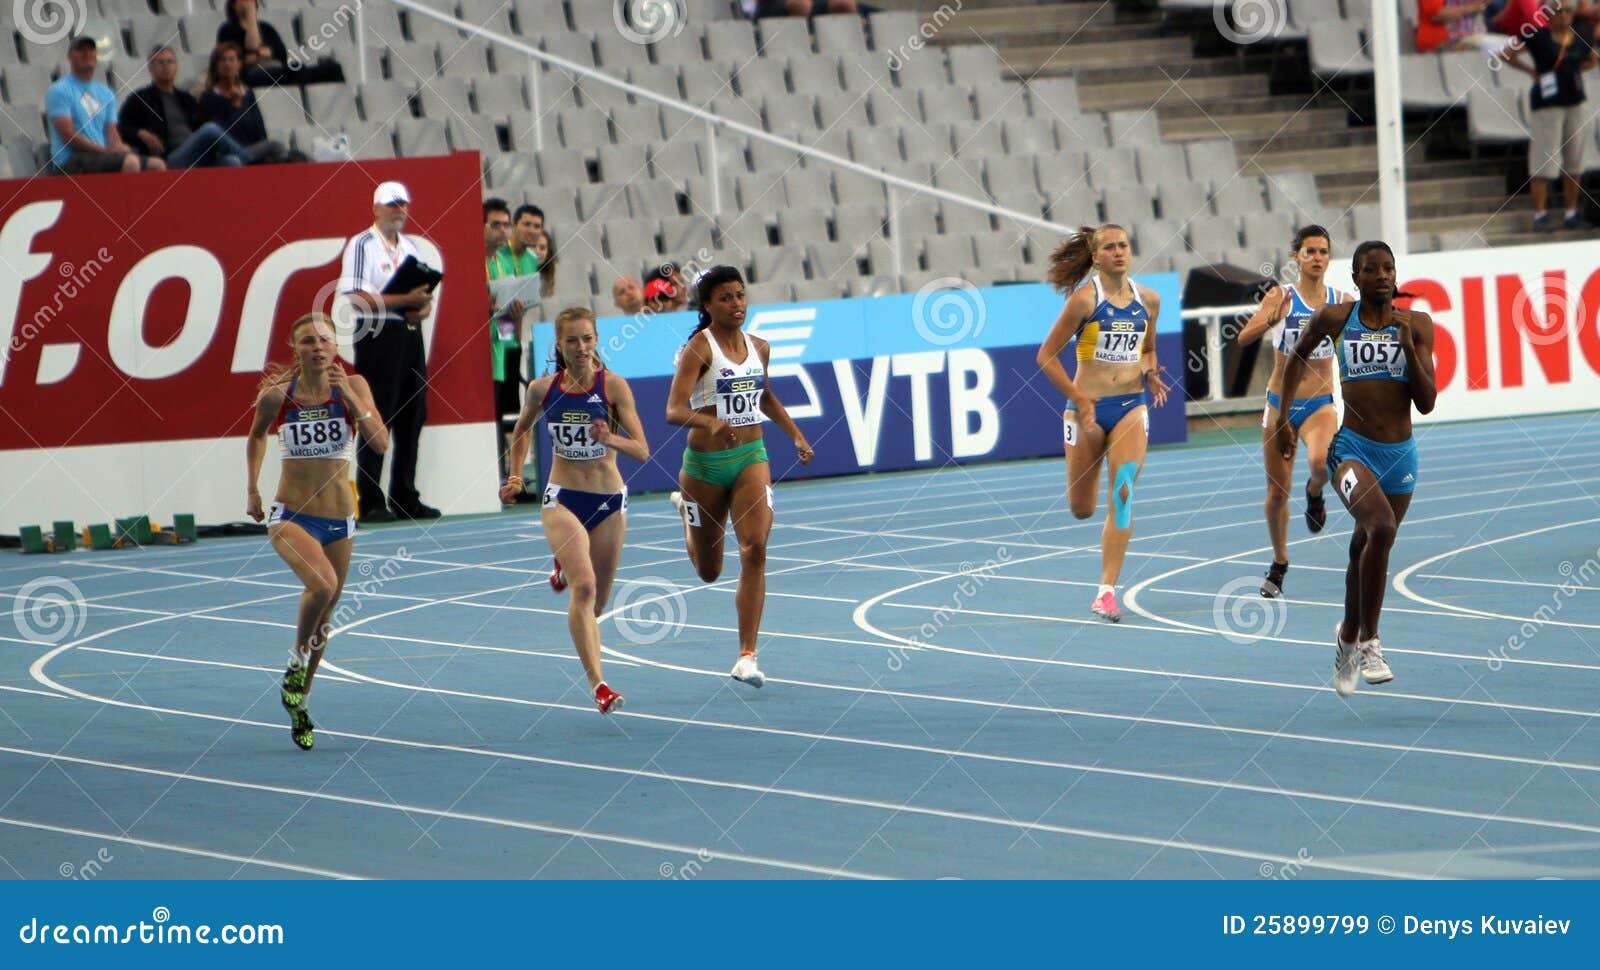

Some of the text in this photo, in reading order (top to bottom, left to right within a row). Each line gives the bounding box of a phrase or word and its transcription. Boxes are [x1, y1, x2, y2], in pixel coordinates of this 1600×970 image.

[1103, 333, 1139, 351] 1718
[1350, 342, 1402, 364] 1057
[1349, 363, 1388, 376] BARCELONA
[832, 347, 1000, 467] VTB
[289, 420, 342, 446] 1588
[1066, 424, 1072, 442] 3
[290, 446, 330, 457] BARCELONA
[686, 505, 695, 523] 5
